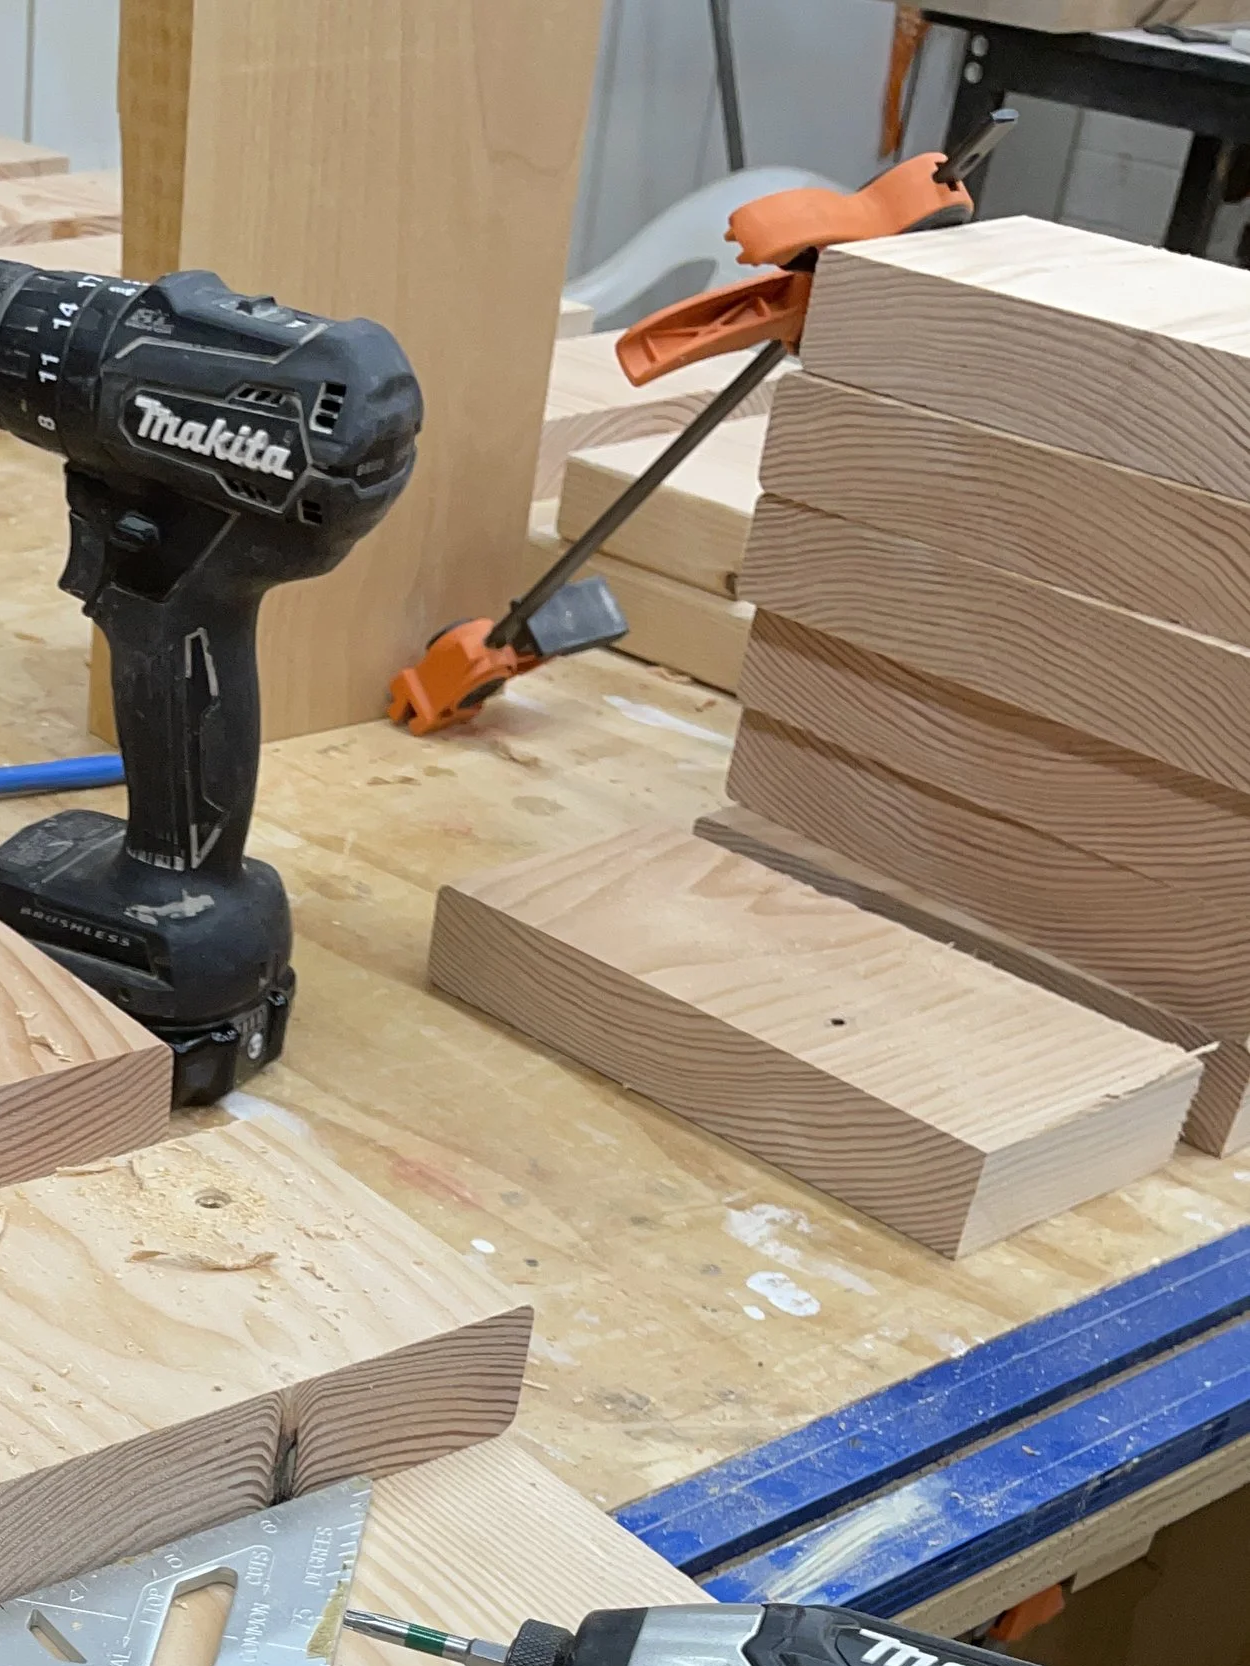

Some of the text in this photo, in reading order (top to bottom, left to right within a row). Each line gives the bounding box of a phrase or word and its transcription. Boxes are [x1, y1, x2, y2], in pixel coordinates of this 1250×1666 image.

[53, 302, 79, 330] 14
[38, 352, 60, 383] 11
[19, 905, 131, 948] BRUSHLESS
[304, 1526, 334, 1586] DEGREES
[239, 1602, 271, 1663] COMMON
